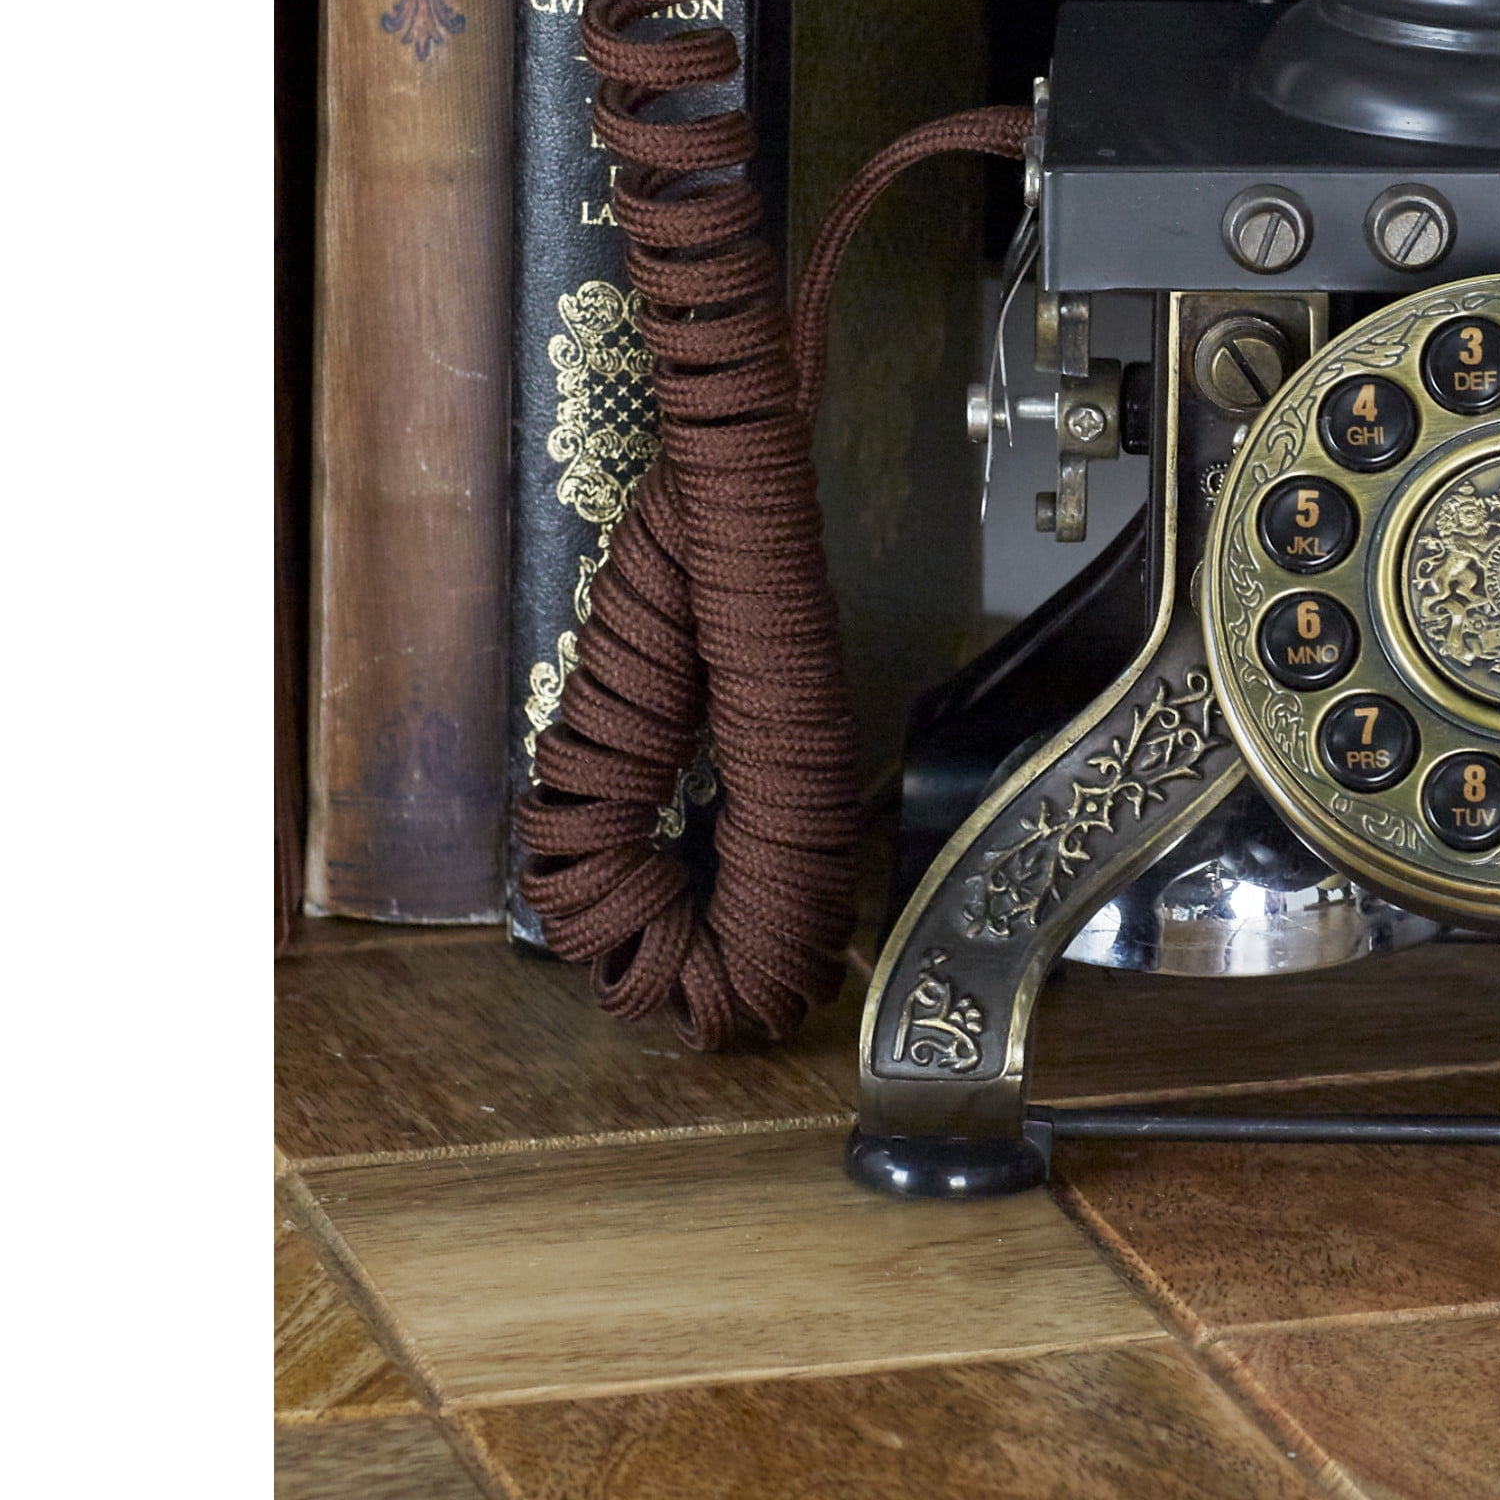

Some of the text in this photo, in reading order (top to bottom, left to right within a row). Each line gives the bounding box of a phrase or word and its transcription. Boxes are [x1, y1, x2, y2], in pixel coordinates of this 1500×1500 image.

[1460, 326, 1483, 365] 3
[1454, 371, 1498, 392] DEF
[1352, 384, 1377, 421] 4
[1346, 426, 1385, 446] GHI
[1295, 489, 1319, 528] 5
[1287, 537, 1326, 556] JKL
[1296, 601, 1321, 640] 6
[1287, 645, 1339, 665] MNO
[1354, 706, 1379, 745] 7
[1346, 749, 1390, 769] PRS
[1463, 764, 1487, 803] 8
[1451, 807, 1497, 828] TUV
